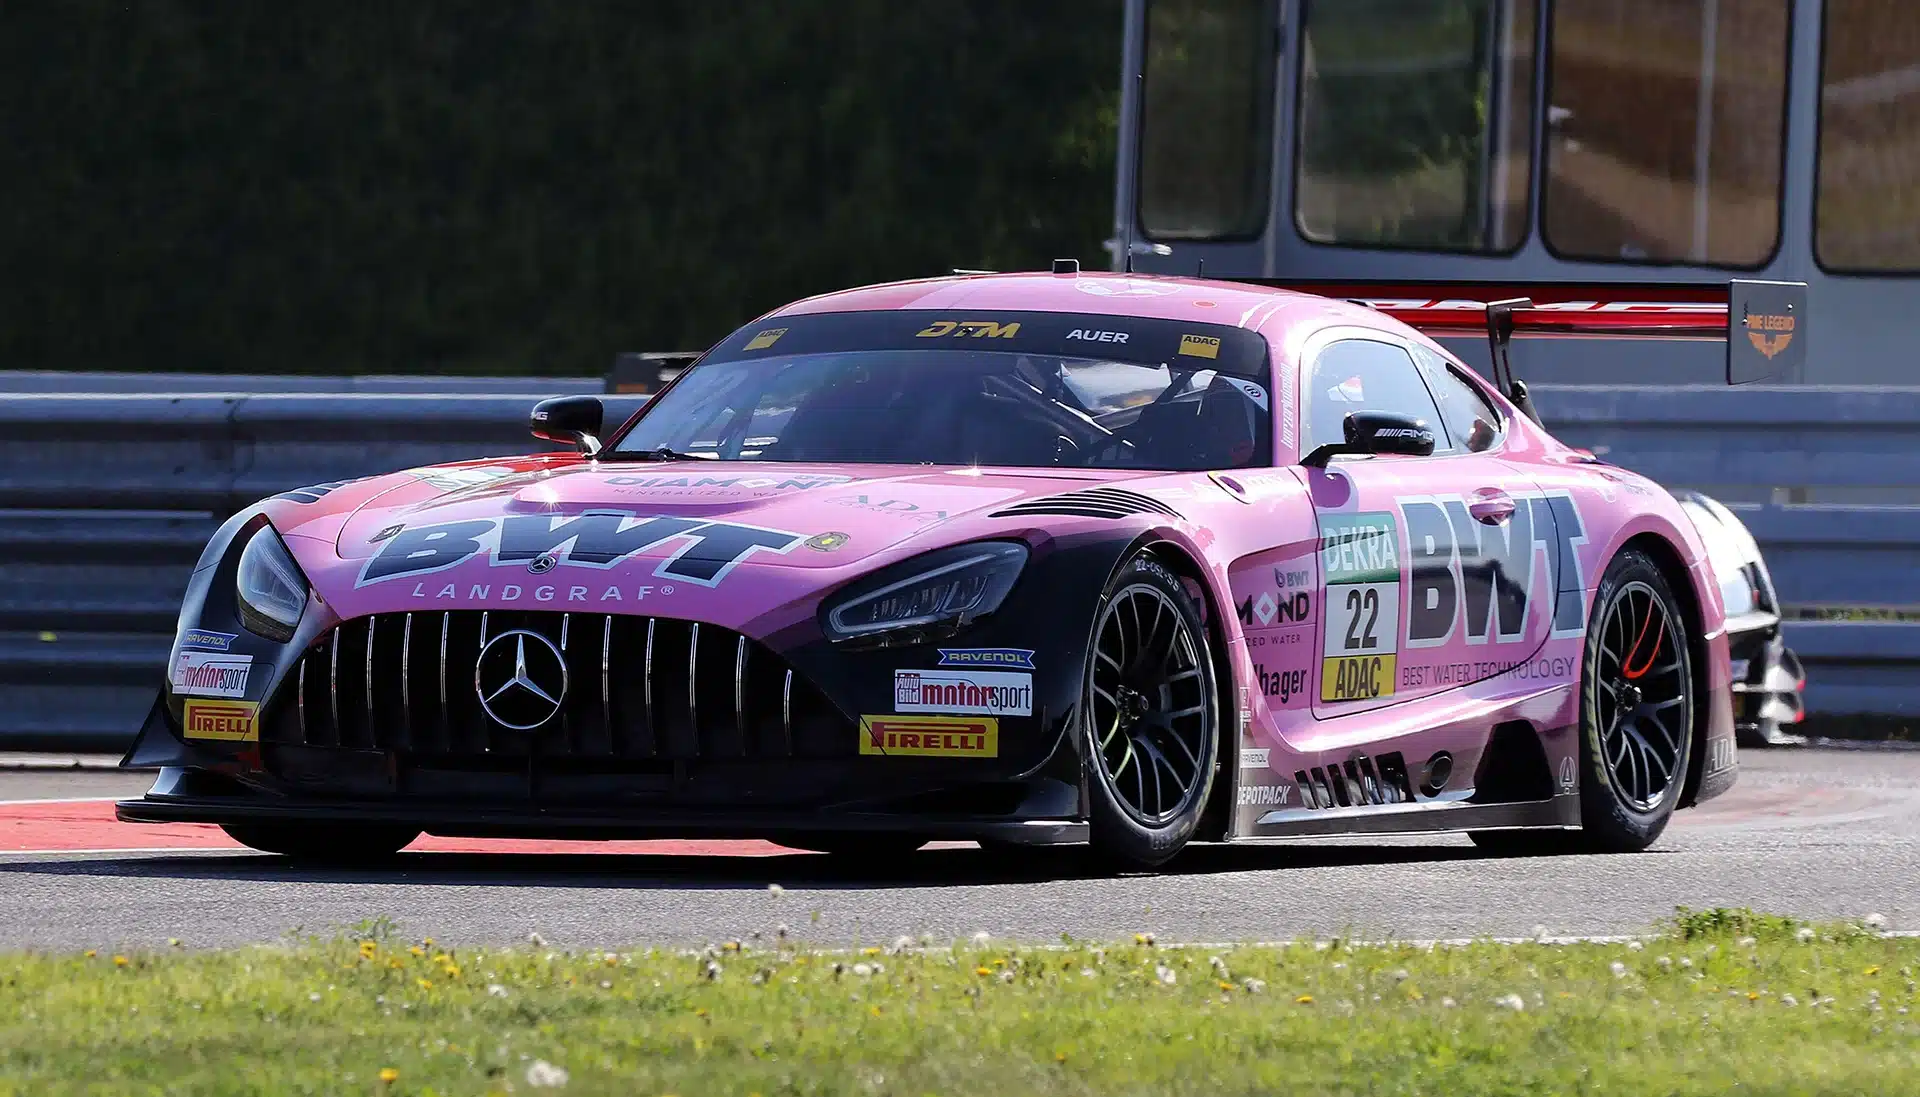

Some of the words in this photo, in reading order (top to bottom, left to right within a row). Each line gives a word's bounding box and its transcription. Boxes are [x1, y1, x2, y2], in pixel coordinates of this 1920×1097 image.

[915, 322, 1021, 338] DTM
[1066, 329, 1130, 344] AUER
[1184, 335, 1218, 346] ADAC
[1399, 428, 1434, 441] AMG
[354, 508, 805, 590] BWT
[1324, 524, 1398, 572] DEKRA
[1287, 571, 1310, 587] BWT
[1394, 489, 1590, 649] BWT
[1344, 588, 1380, 649] 22
[1271, 634, 1301, 645] WATER
[949, 652, 1026, 663] RAVENOL
[1403, 665, 1430, 686] BEST
[1434, 663, 1471, 684] WATER
[1475, 656, 1575, 680] TECHNOLOGY
[1335, 656, 1382, 698] ADAC
[922, 682, 1031, 711] motorsport
[188, 705, 255, 733] PIRELLI
[871, 721, 987, 750] PIRELLI
[1237, 785, 1292, 805] DEPOTPACK
